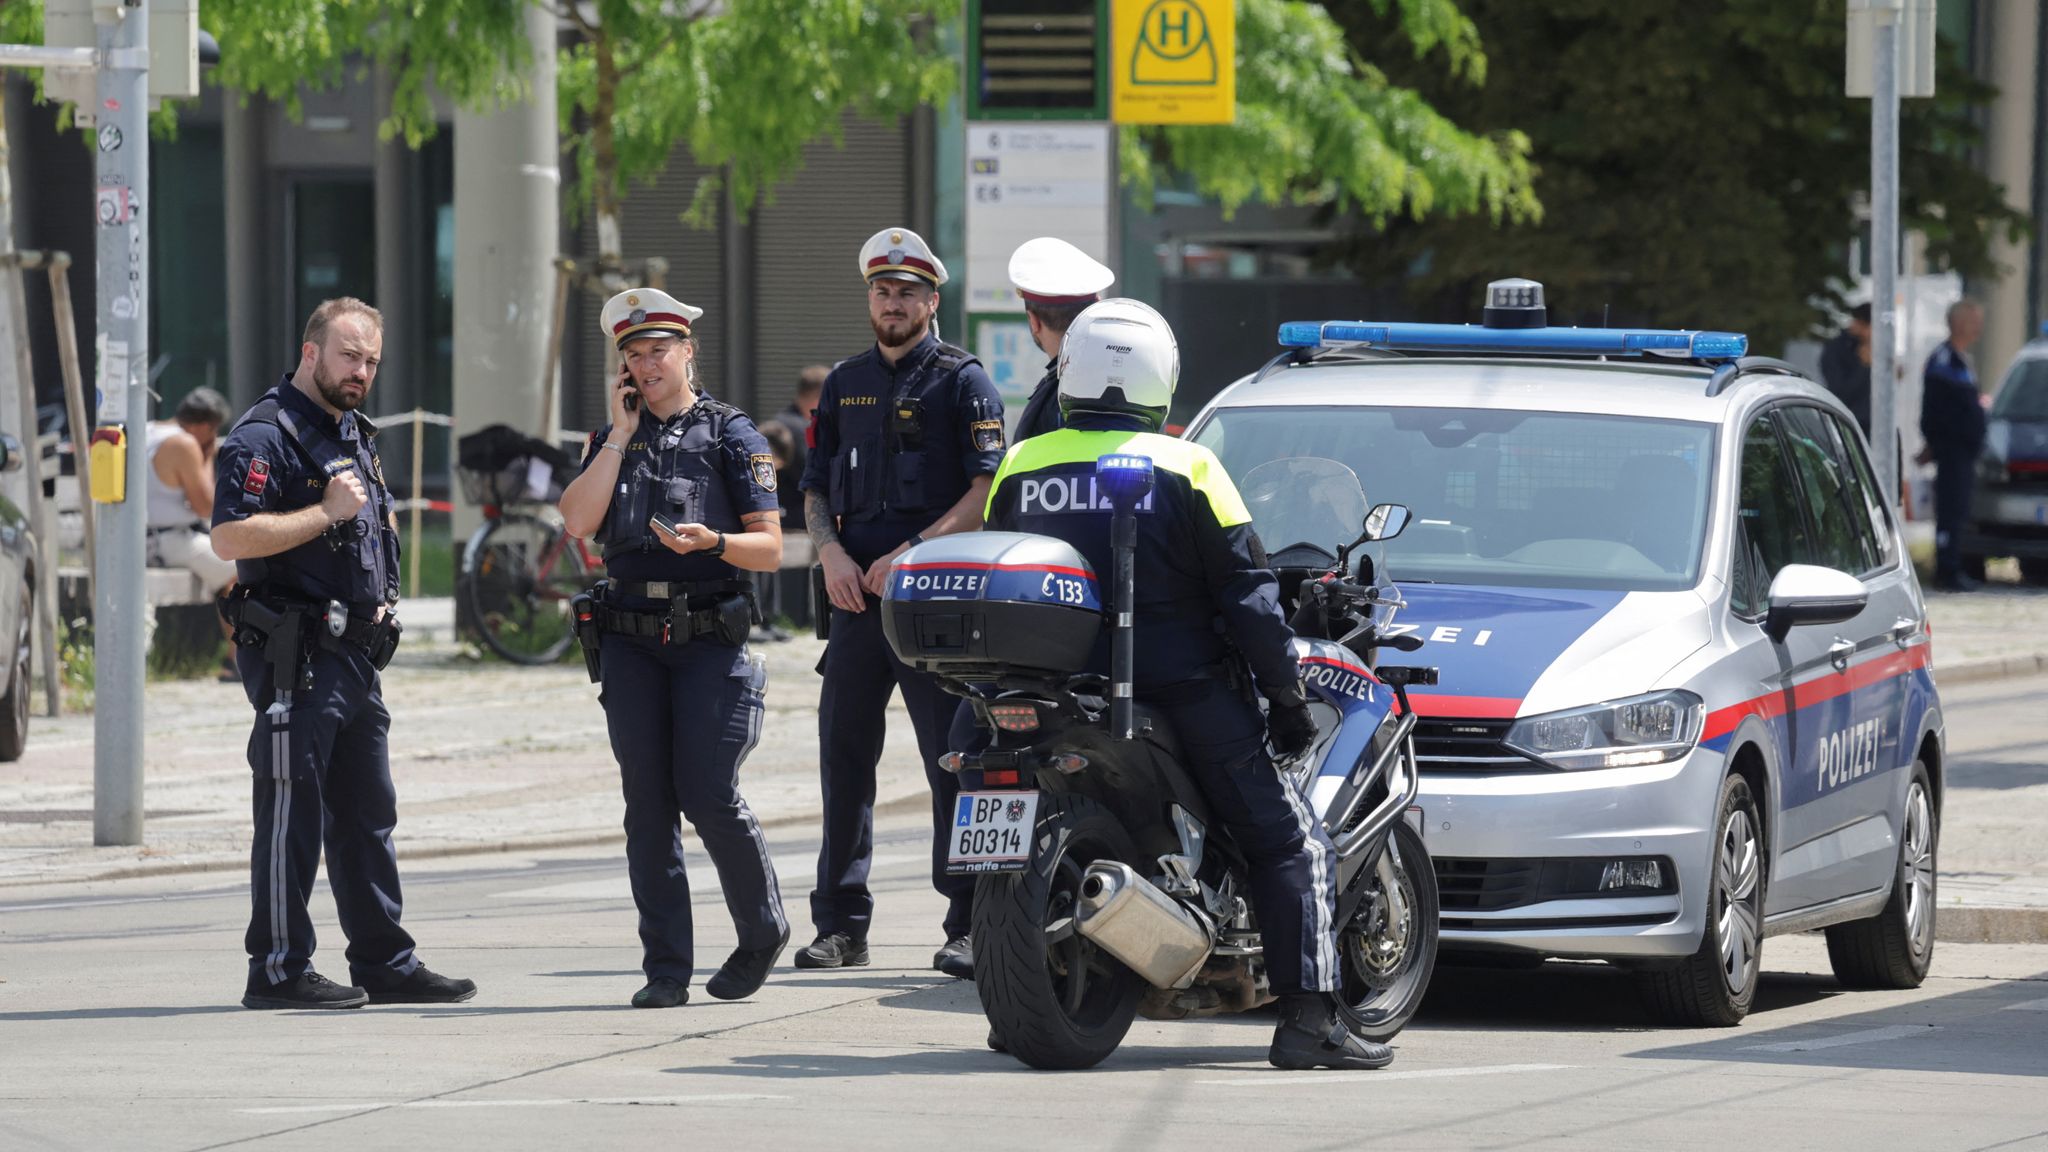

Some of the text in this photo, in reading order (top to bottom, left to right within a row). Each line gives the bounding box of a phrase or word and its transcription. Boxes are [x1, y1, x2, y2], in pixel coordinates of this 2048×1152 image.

[1161, 10, 1188, 48] H
[988, 132, 1001, 151] 6
[840, 396, 877, 407] POLIZEI
[1021, 477, 1152, 512] POLII
[902, 575, 987, 590] POLIZEI
[1056, 579, 1084, 605] 133
[1304, 665, 1375, 703] POLIZEI
[1817, 717, 1879, 792] POLIZEI
[960, 815, 968, 824] A
[975, 798, 1003, 823] BP
[959, 828, 1021, 855] 60314
[966, 861, 999, 872] neffe
